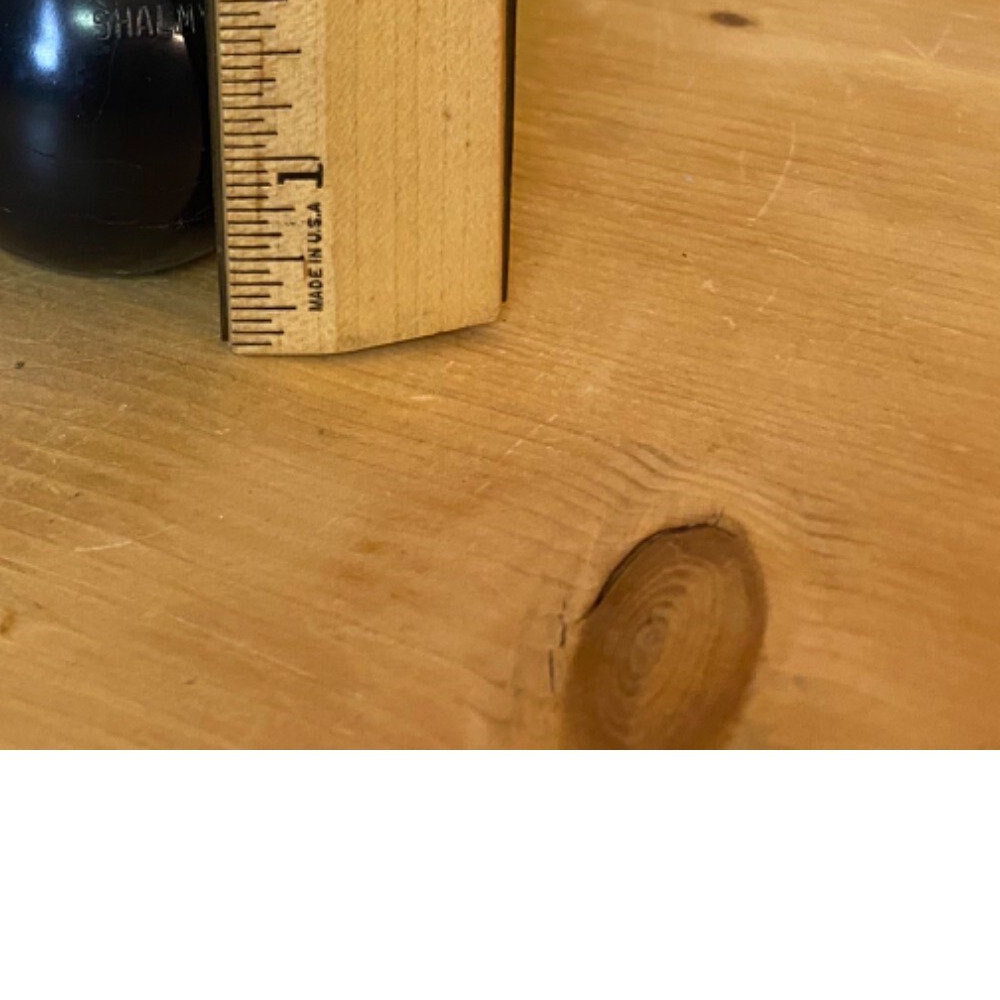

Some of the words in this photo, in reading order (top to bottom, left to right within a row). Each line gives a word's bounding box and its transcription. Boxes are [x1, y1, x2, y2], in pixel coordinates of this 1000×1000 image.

[276, 162, 324, 189] 1
[307, 247, 323, 264] IN
[307, 267, 324, 312] MADE
